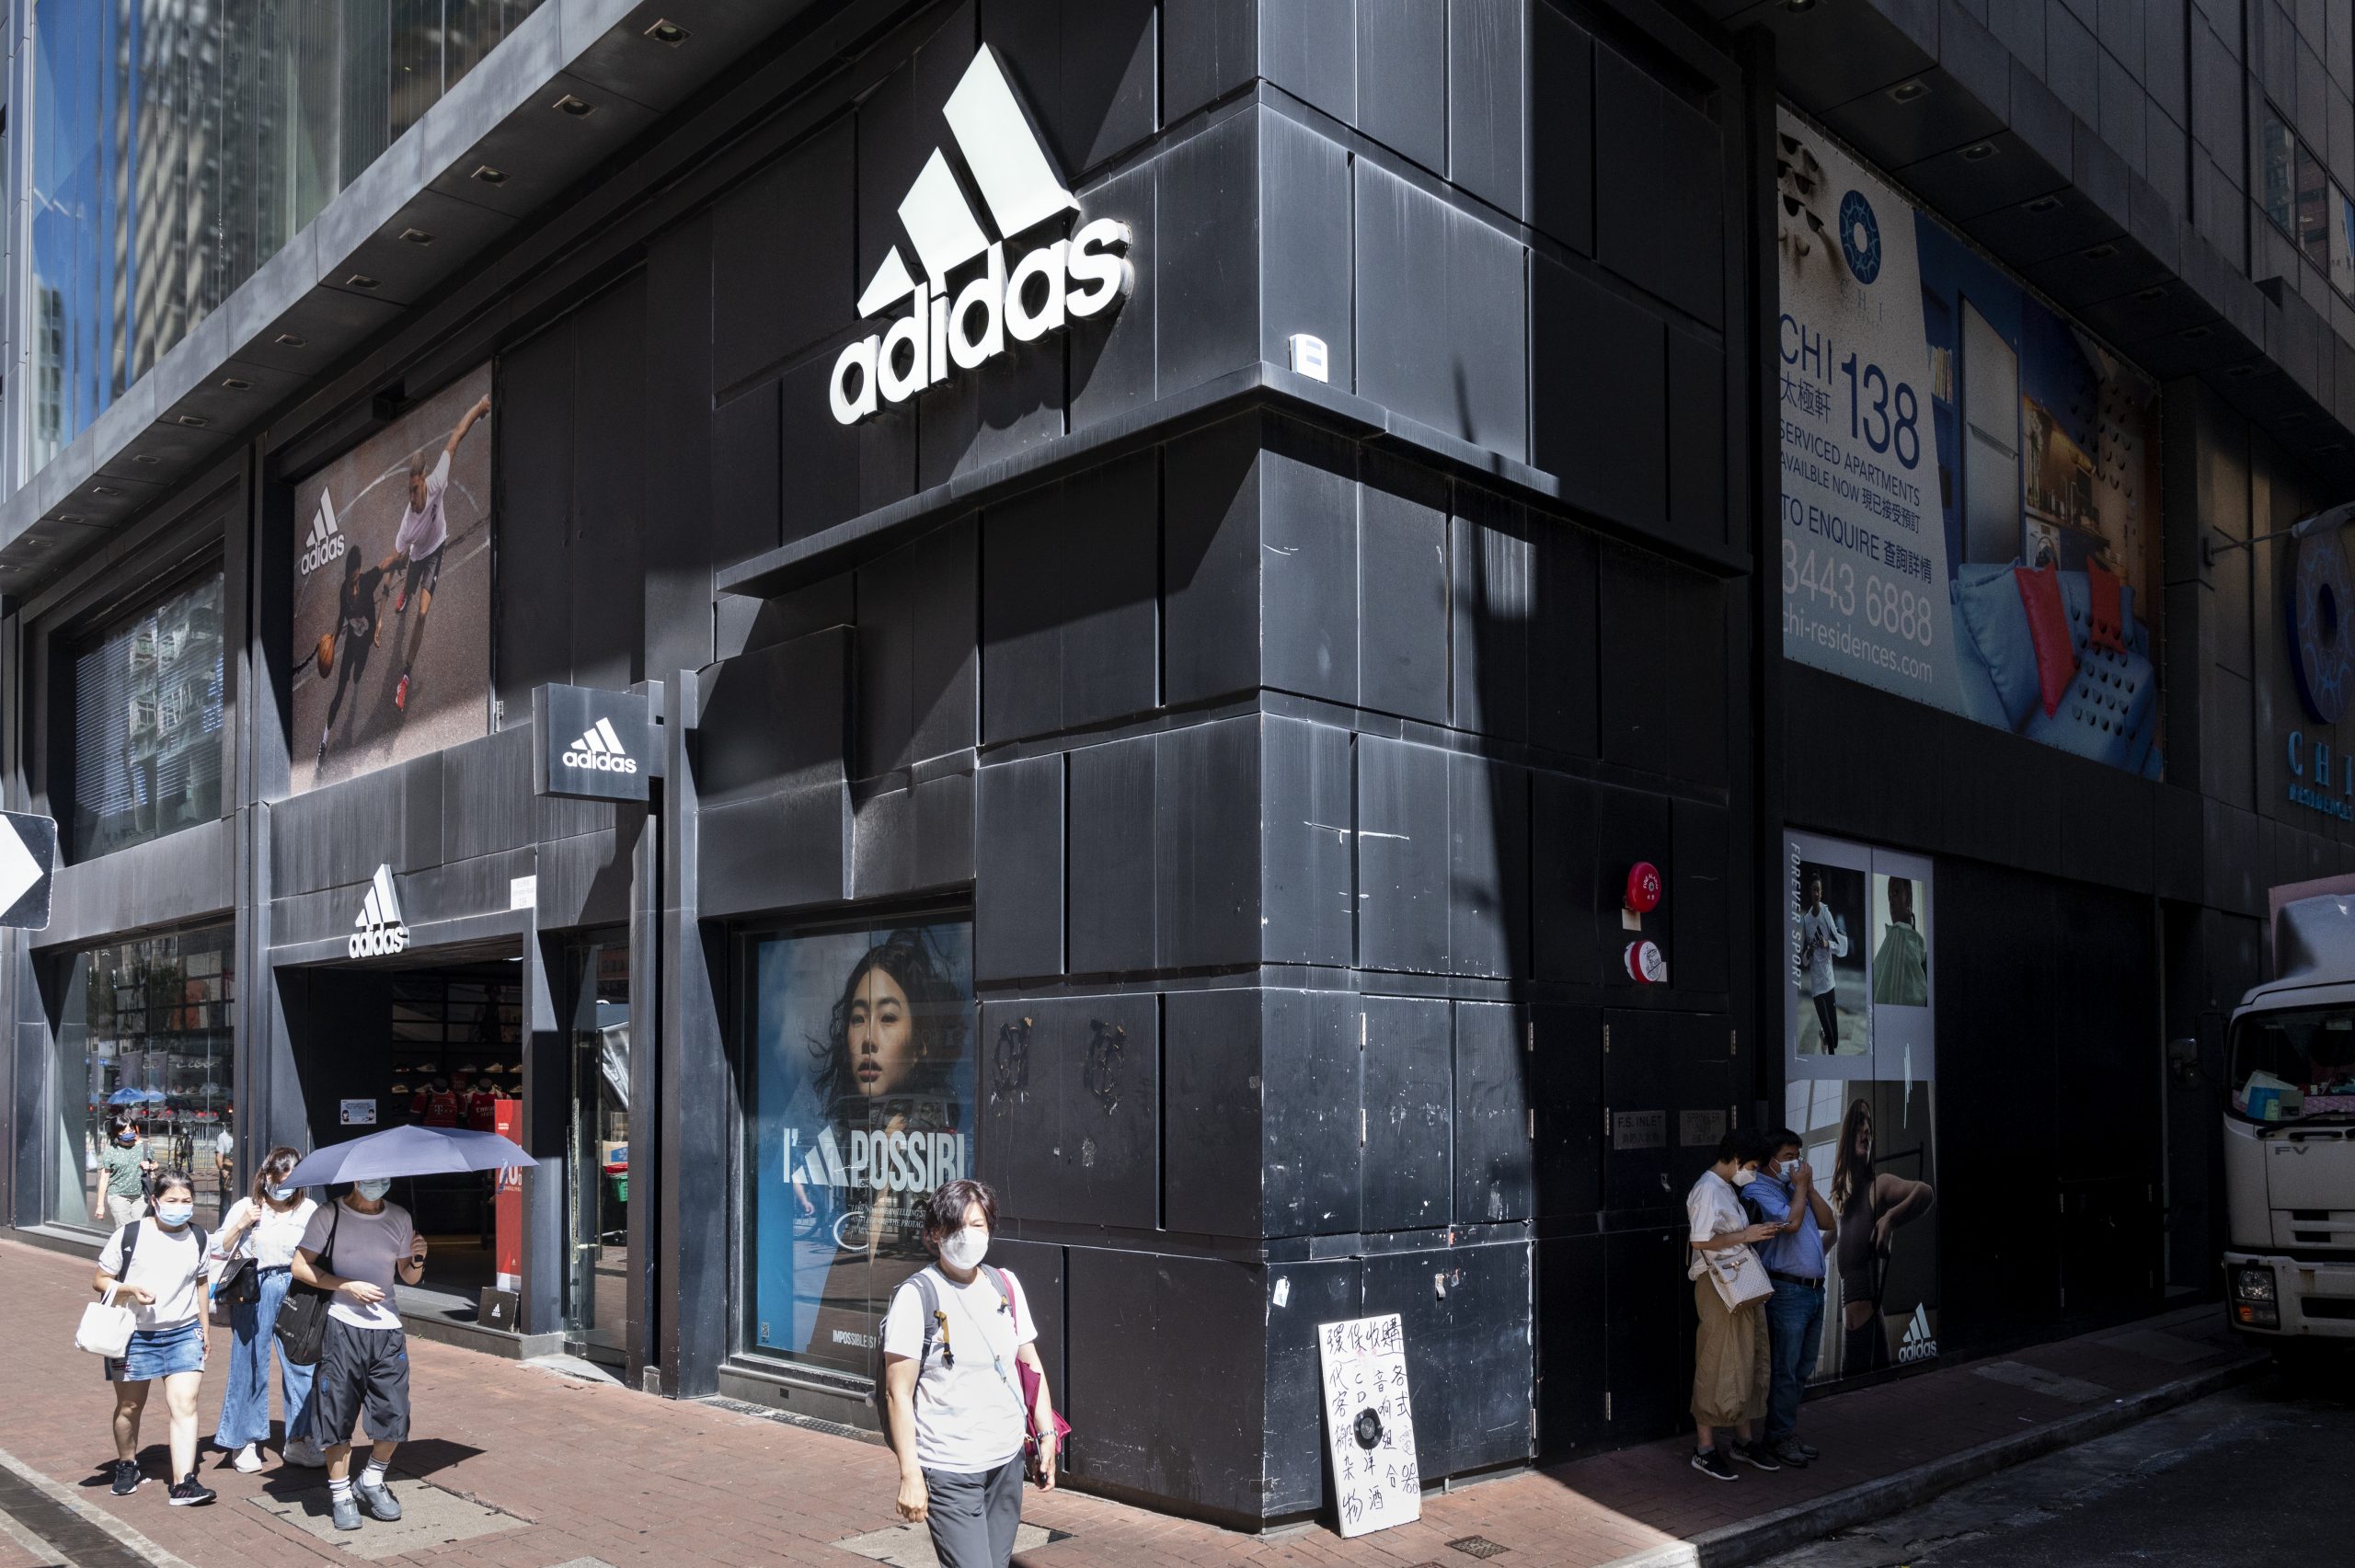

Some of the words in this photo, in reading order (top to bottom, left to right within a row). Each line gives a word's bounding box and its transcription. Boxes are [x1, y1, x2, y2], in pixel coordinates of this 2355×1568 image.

[830, 217, 1134, 426] adidas
[1780, 313, 1832, 384] CHI
[1780, 372, 1832, 423] 太極軒
[1842, 352, 1920, 470] 138
[1832, 475, 1859, 502] NOW
[1844, 452, 1920, 507] APARTMENTS
[1782, 494, 1803, 526] TO
[1809, 506, 1880, 561] ENQUIRE
[1862, 488, 1921, 533] 現已接受預訂
[301, 532, 345, 576] adidas
[1884, 540, 1932, 585] 查詢詳情
[1783, 538, 1855, 616] 3443
[1866, 575, 1933, 647] 6888
[562, 749, 637, 774] adidas
[1791, 842, 1802, 923] FOREVER
[349, 921, 408, 959] adidas
[1791, 929, 1802, 990] SPORT
[1618, 1116, 1635, 1127] F.S.
[1636, 1115, 1662, 1127] INLET
[2275, 1146, 2310, 1156] FV
[833, 1330, 867, 1347] IMPOSSIBLE
[1899, 1338, 1937, 1363] adidas
